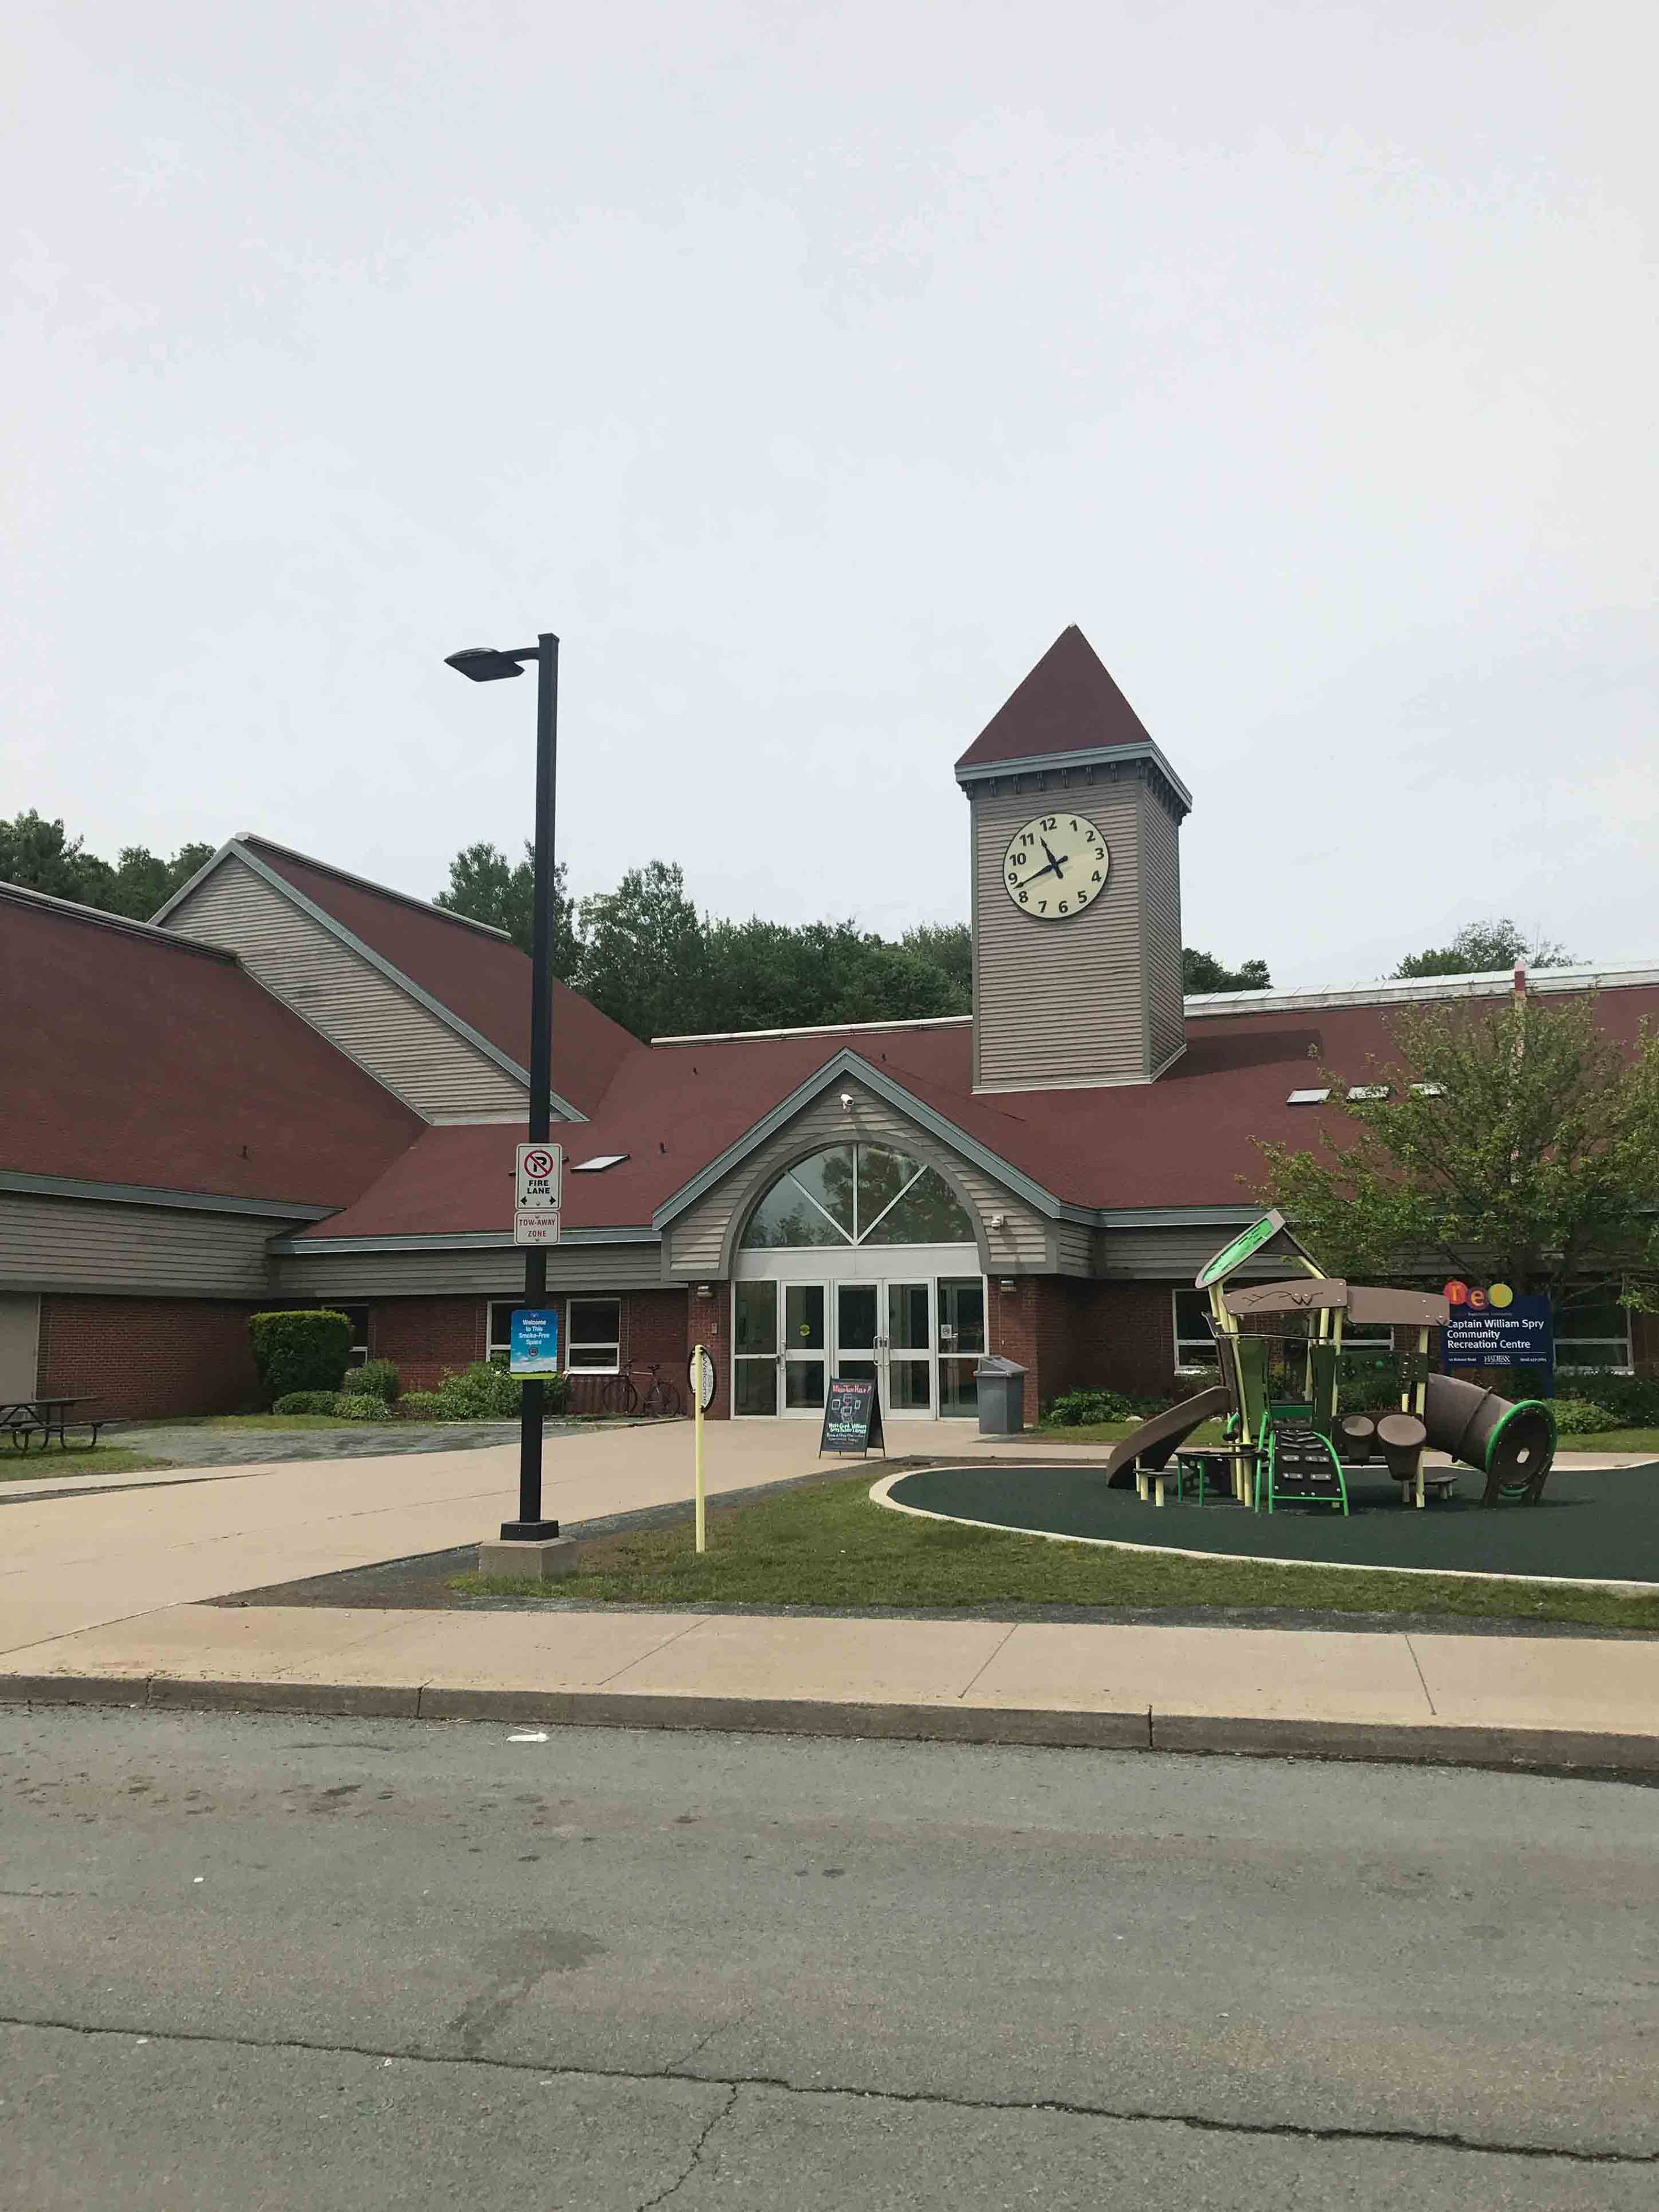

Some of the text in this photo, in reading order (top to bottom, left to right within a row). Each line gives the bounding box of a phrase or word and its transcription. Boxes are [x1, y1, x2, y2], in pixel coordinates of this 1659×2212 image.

[1039, 817, 1057, 831] 12
[1070, 820, 1078, 832] 1
[1019, 833, 1034, 846] 11
[1085, 830, 1095, 842] 2
[1009, 853, 1026, 866] 10
[1095, 847, 1104, 860] 3
[1008, 873, 1018, 885] 9
[1091, 870, 1102, 883] 4
[1019, 891, 1029, 903] 8
[1078, 890, 1087, 904] 5
[1038, 901, 1047, 913] 7
[1058, 900, 1068, 913] 6
[1447, 1319, 1544, 1330] Captain William Spry
[1447, 1330, 1500, 1340] Community
[1448, 1340, 1531, 1349] Recreation Centre
